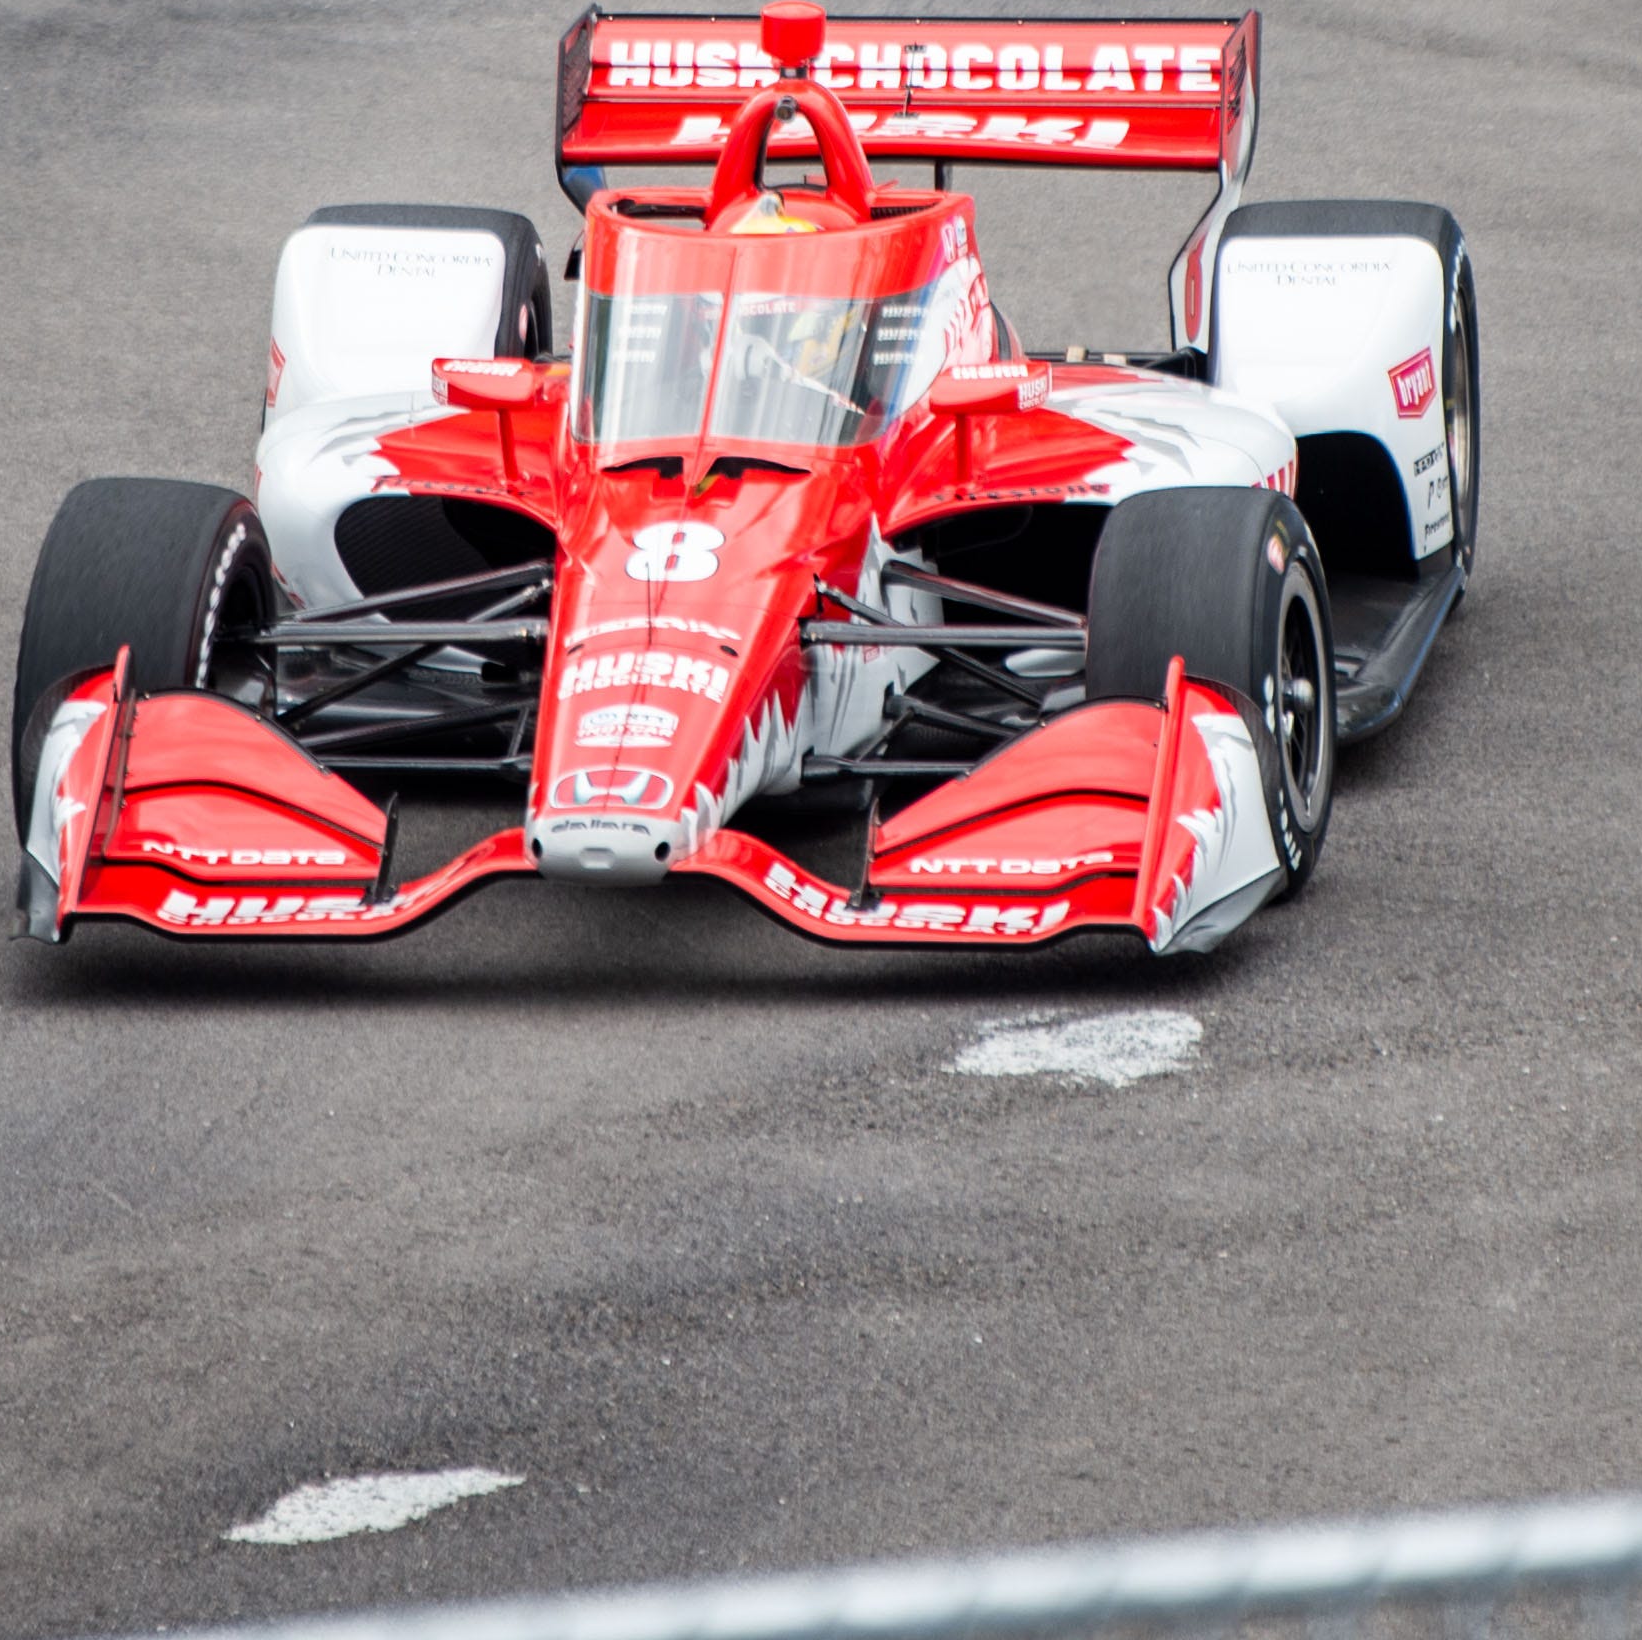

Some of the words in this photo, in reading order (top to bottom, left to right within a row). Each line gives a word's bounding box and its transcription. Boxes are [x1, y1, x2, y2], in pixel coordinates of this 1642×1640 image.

[609, 41, 781, 89] HUSK
[809, 44, 1223, 92] CHOCOLATE
[1396, 360, 1433, 407] bryant
[625, 520, 726, 582] 8
[560, 651, 730, 692] HUSKI
[141, 839, 229, 865] NTT
[909, 857, 998, 875] NTT
